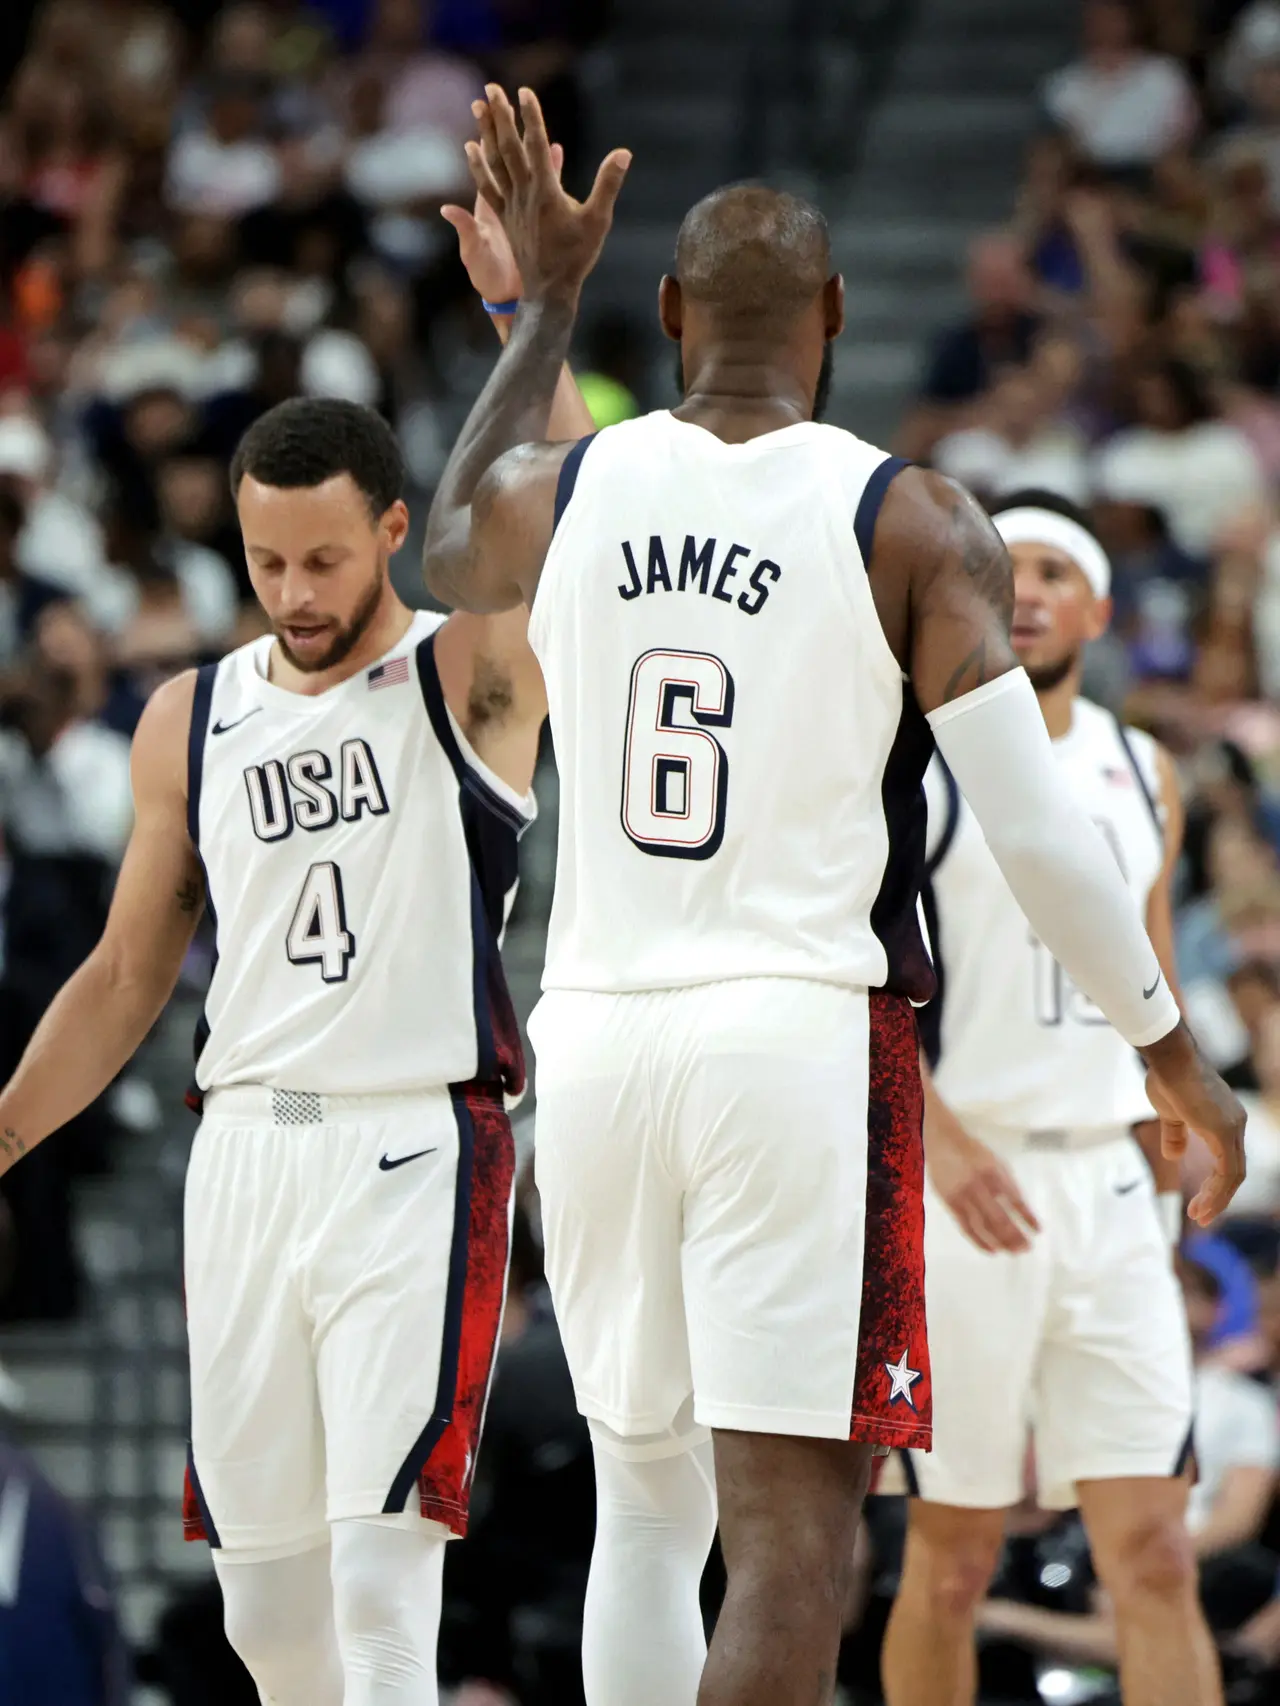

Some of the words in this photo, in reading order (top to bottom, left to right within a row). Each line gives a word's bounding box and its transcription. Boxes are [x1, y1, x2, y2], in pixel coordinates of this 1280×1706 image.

[617, 534, 782, 616] JAMES
[243, 738, 390, 843] USA
[620, 648, 735, 861] 6
[285, 861, 356, 984] 4
[1027, 920, 1113, 1028] 1
